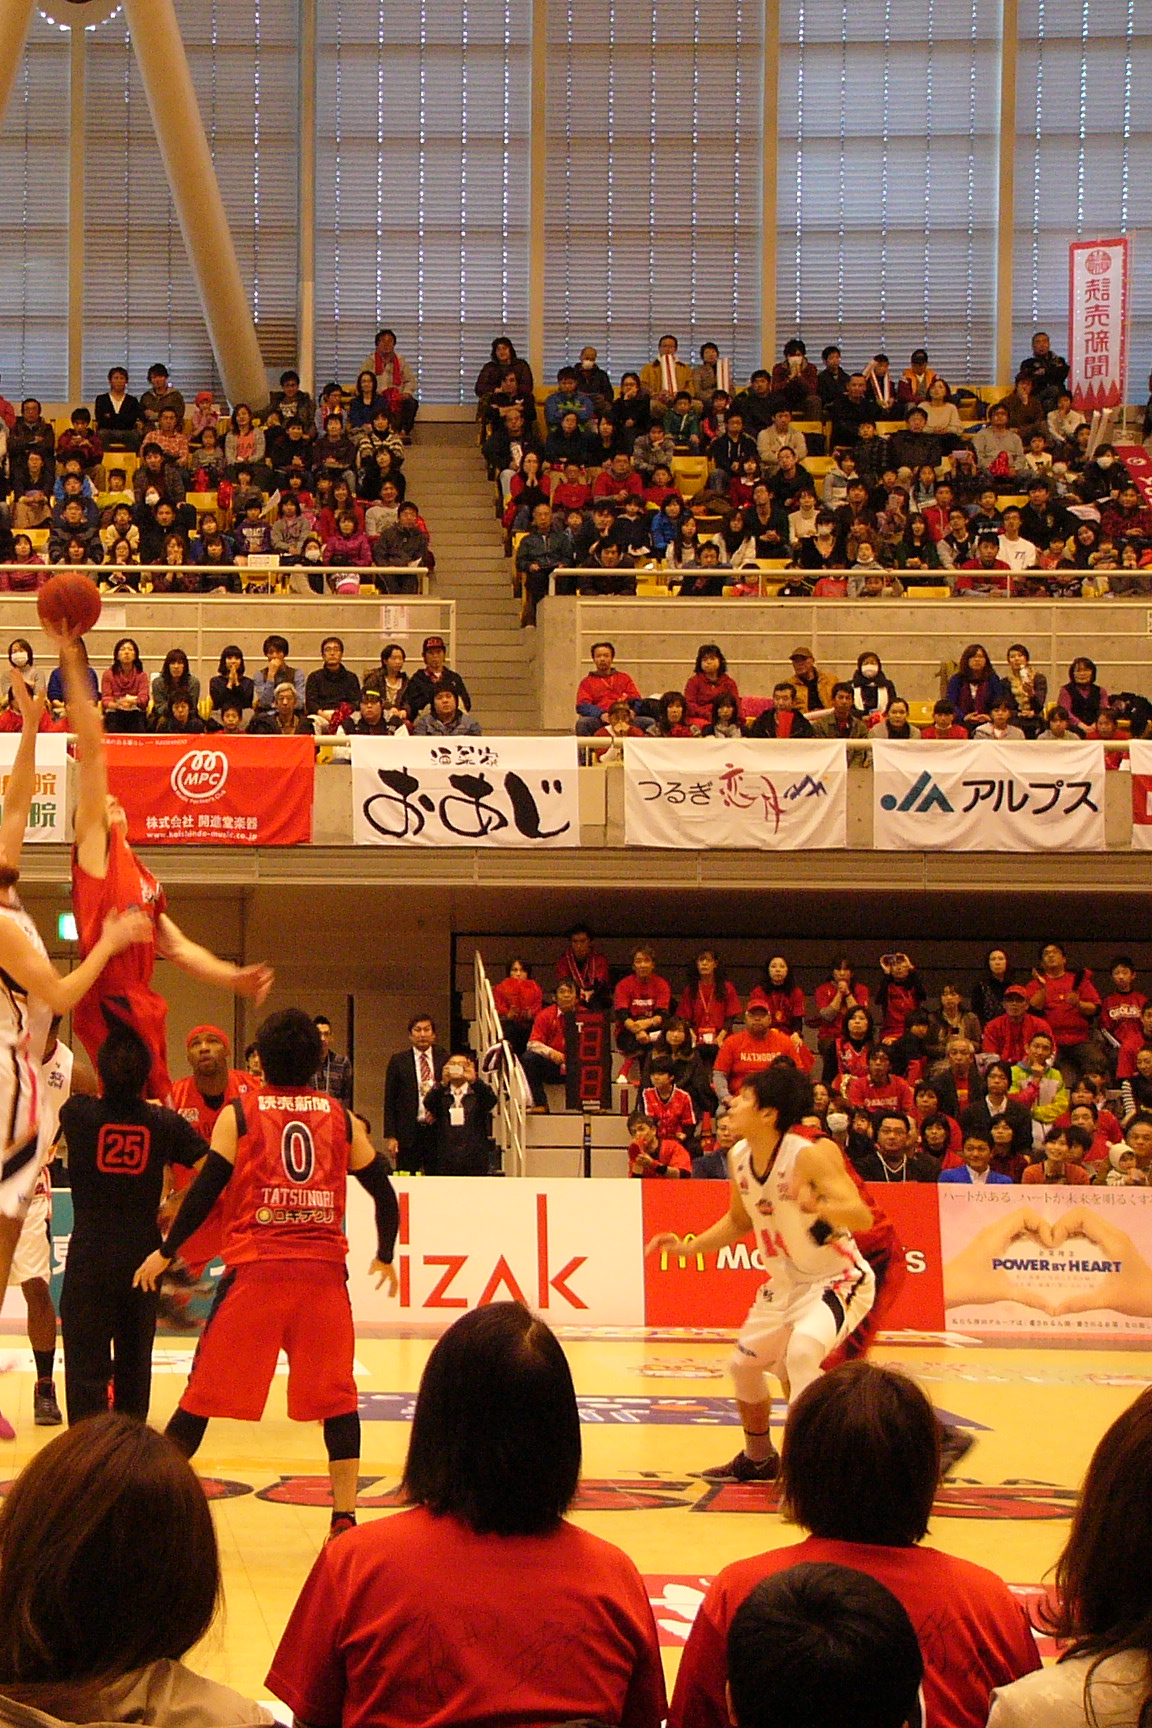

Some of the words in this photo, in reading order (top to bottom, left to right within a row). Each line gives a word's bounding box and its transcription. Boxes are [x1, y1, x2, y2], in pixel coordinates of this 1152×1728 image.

[184, 772, 221, 786] MPC
[961, 779, 1099, 815] アルプス
[145, 815, 195, 830] 株式会社
[104, 1133, 142, 1164] 25
[261, 1188, 335, 1208] TATSUNORI
[992, 1258, 1050, 1272] POWER
[1051, 1262, 1067, 1273] BY
[1068, 1260, 1123, 1273] HEART
